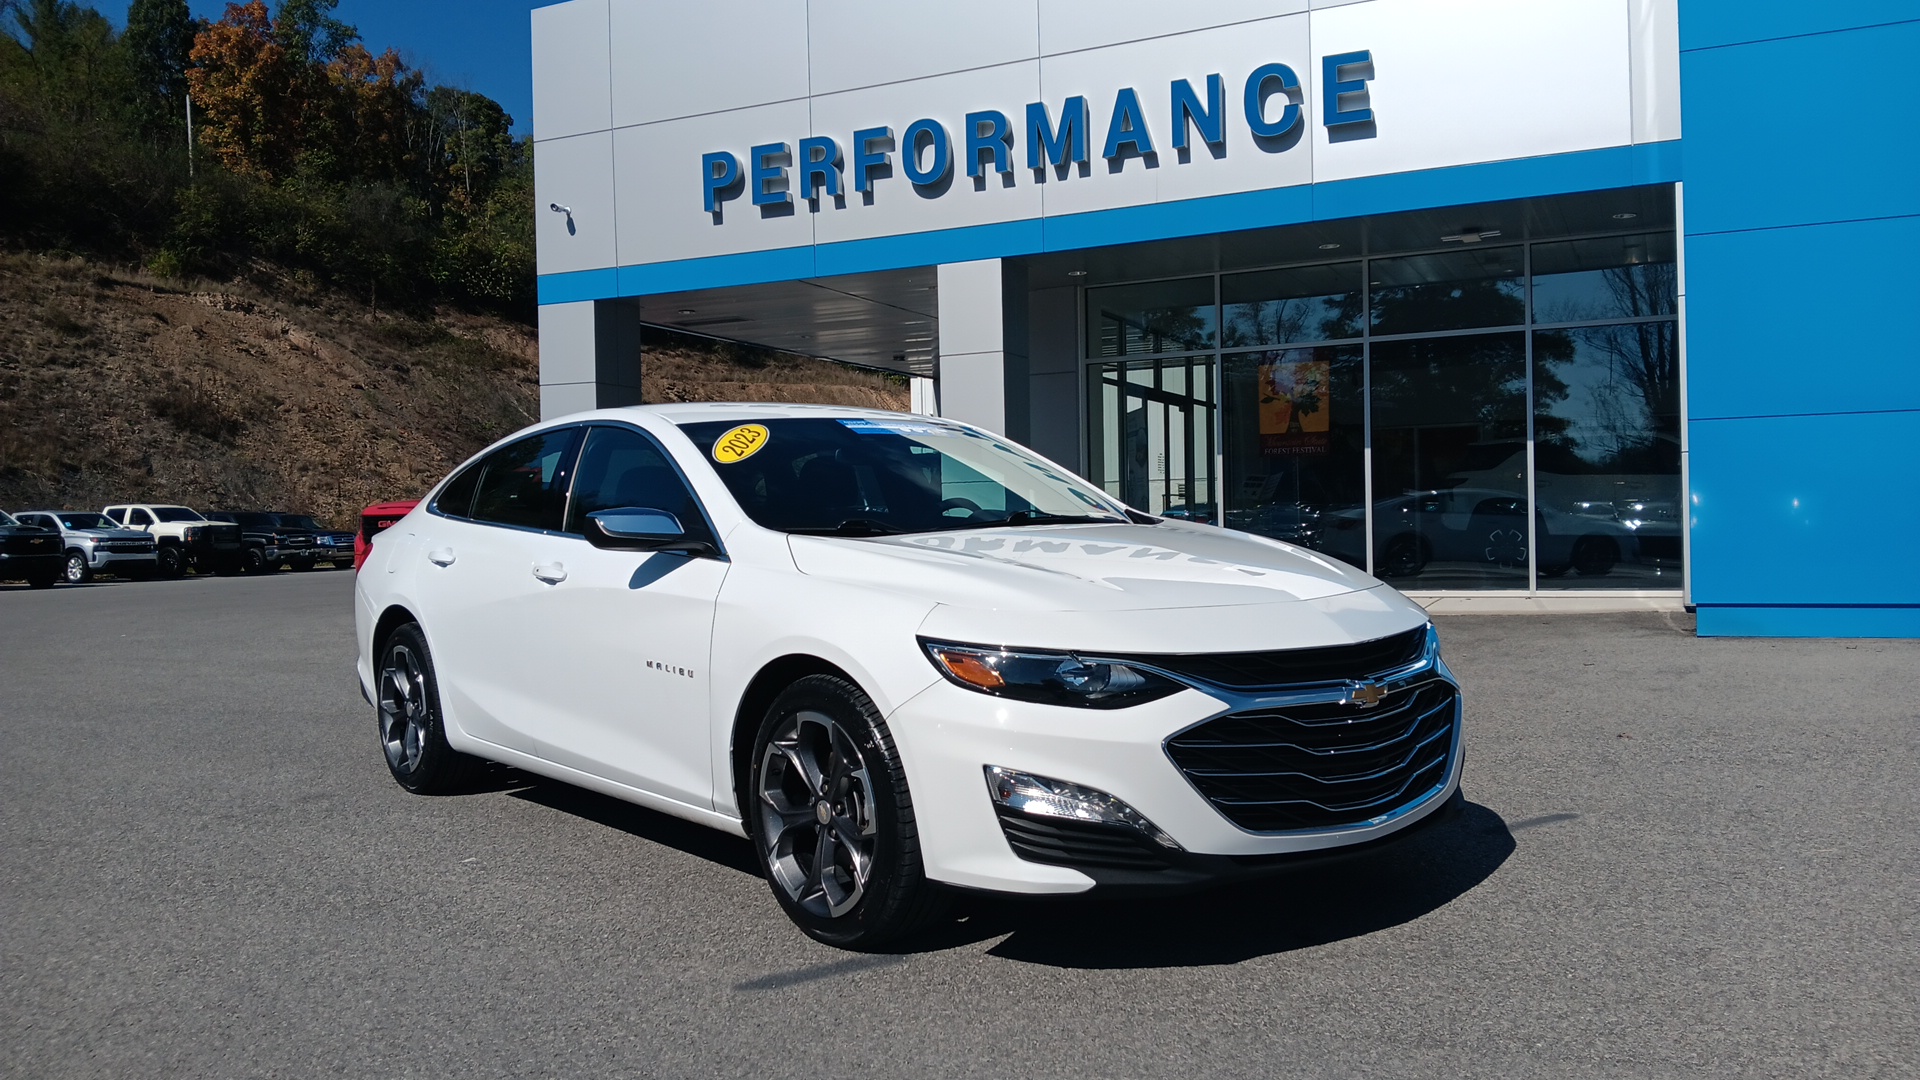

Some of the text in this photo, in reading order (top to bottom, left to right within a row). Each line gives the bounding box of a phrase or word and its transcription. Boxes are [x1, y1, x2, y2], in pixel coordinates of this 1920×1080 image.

[702, 49, 1376, 216] PERFORMANCE
[722, 427, 761, 457] 2023
[1264, 446, 1327, 455] FOREST FESTIVAL
[377, 520, 397, 528] GM
[646, 660, 694, 679] MALIBU
